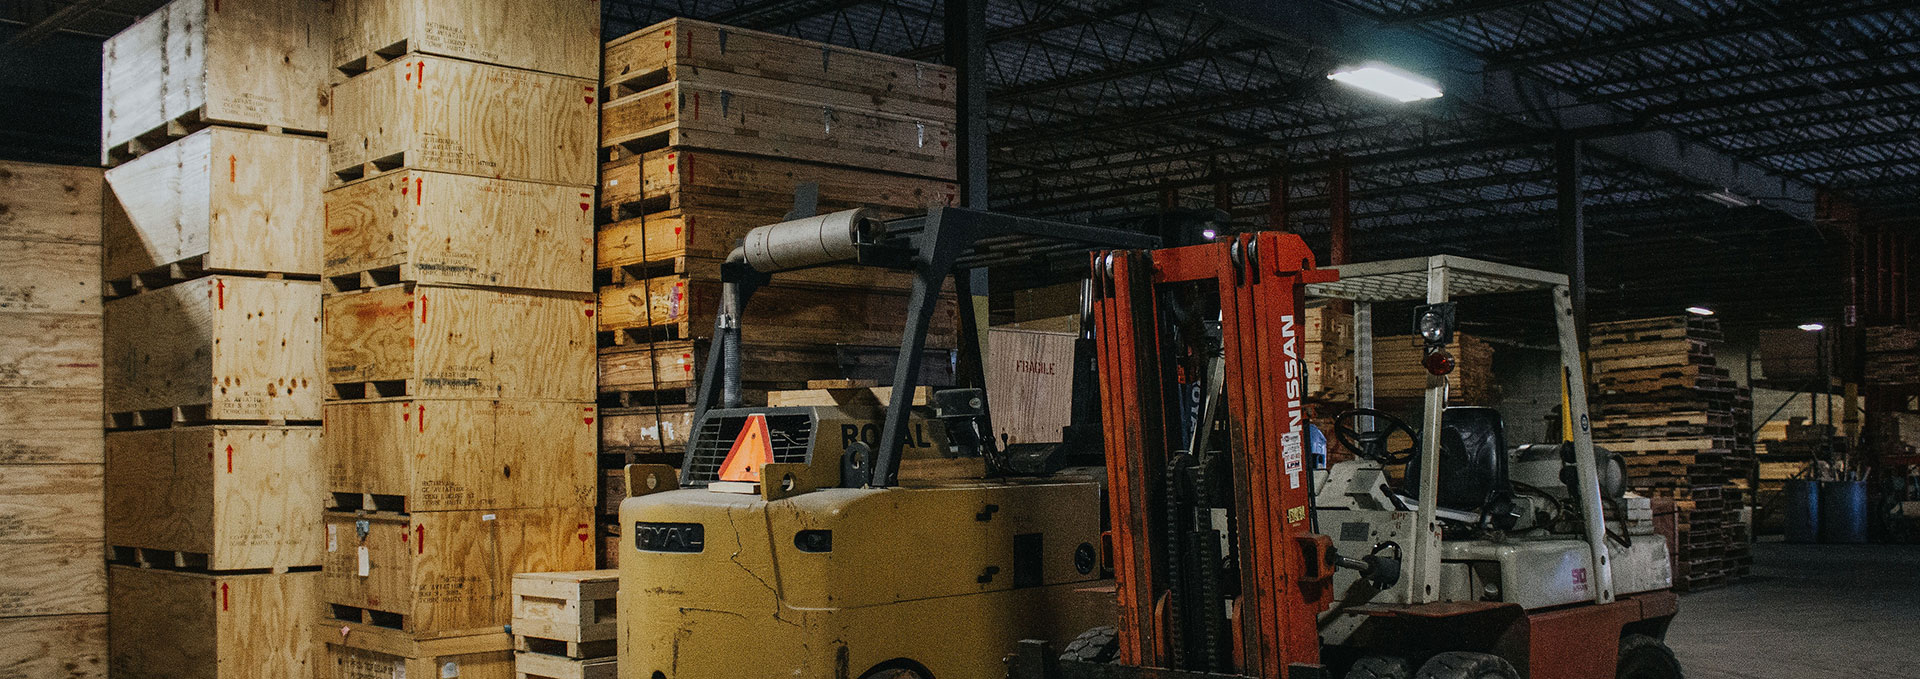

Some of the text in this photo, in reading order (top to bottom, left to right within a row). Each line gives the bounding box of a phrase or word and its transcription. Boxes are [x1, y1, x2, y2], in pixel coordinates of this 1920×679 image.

[1016, 359, 1055, 376] FRAGILE
[1281, 315, 1303, 433] NISSAN
[841, 423, 932, 451] ROAL
